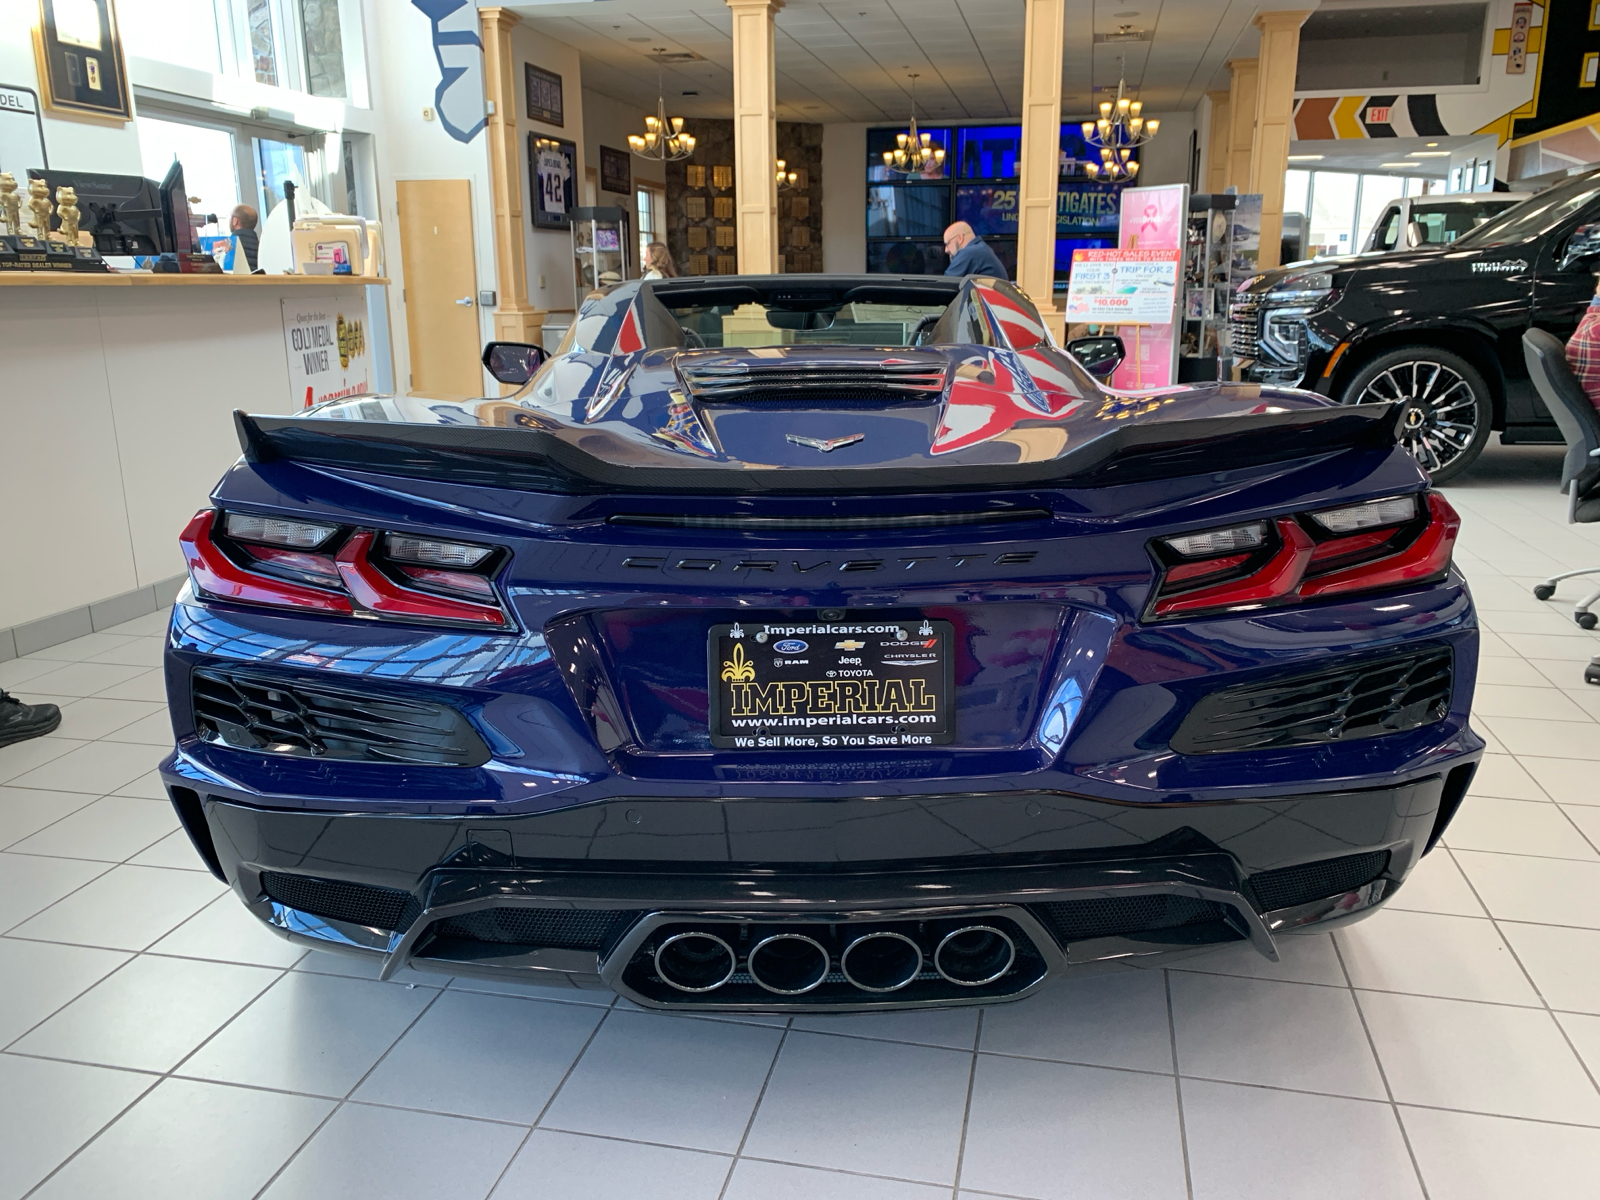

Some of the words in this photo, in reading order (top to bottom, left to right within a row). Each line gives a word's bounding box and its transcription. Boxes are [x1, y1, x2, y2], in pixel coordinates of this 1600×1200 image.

[1371, 107, 1390, 123] EXIT
[545, 173, 563, 203] 42
[991, 190, 1017, 210] 25
[1093, 298, 1129, 306] $10,000
[291, 327, 312, 352] GOLD
[311, 324, 334, 348] MEDAL
[303, 350, 329, 376] WINNER
[621, 551, 1039, 574] CORVETTE
[763, 623, 900, 637] Imperialcars.com
[838, 656, 862, 666] Jeep
[838, 669, 874, 677] TOYOTA
[730, 678, 936, 716] IMPERIAL
[731, 714, 937, 728] www.imperialcars.com
[735, 737, 755, 747] We
[757, 736, 780, 747] Sell
[784, 736, 819, 748] More,
[822, 735, 838, 746] So
[841, 735, 865, 745] You
[868, 735, 898, 745] Save
[901, 734, 932, 744] More
